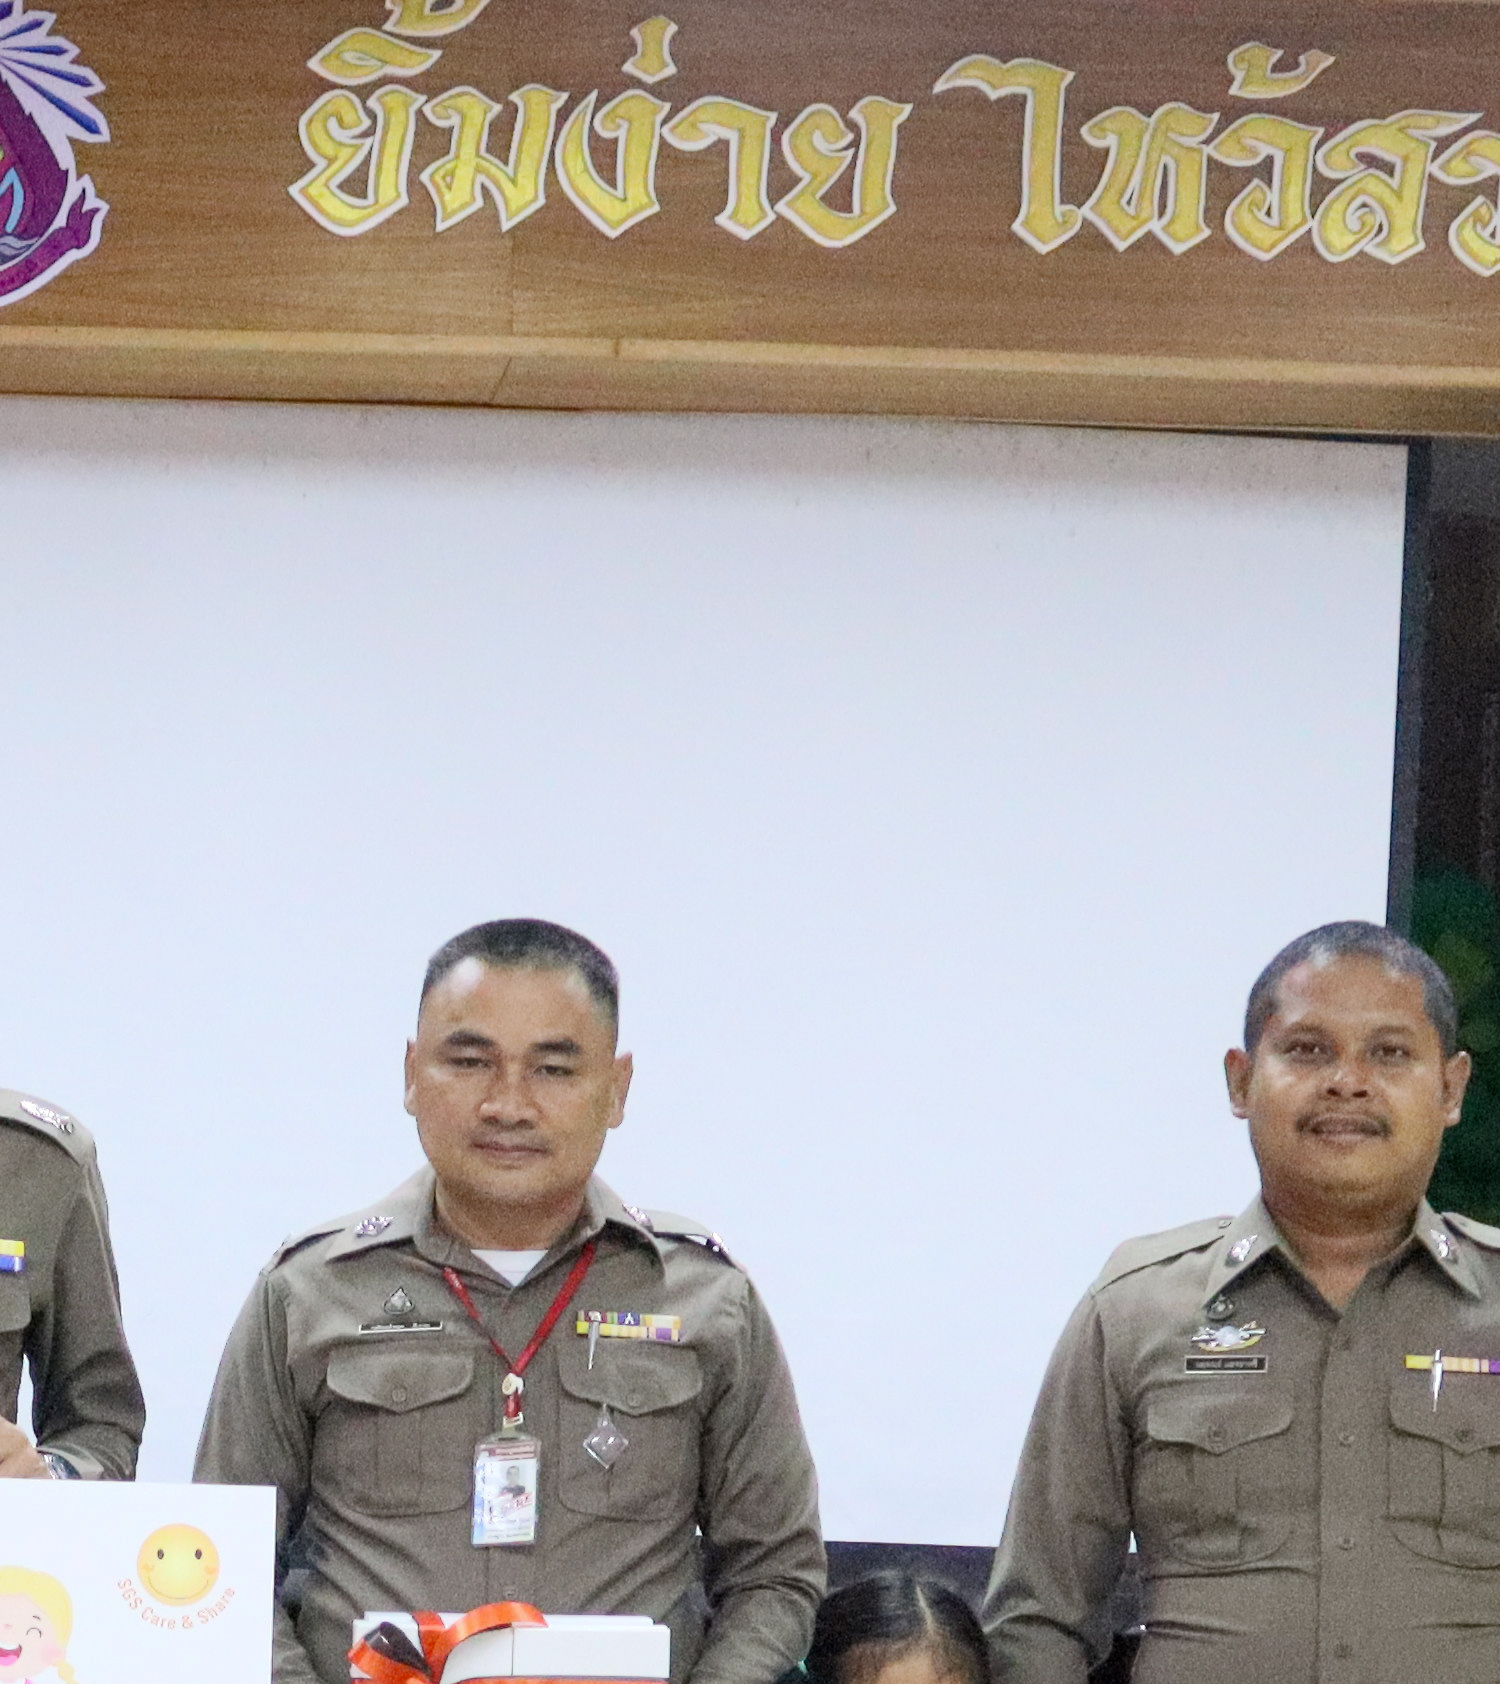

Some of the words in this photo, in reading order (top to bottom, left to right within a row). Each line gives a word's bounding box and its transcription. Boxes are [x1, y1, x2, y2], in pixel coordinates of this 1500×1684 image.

[287, 0, 914, 248] ยิ้มง่าย
[117, 1578, 143, 1610] SGS
[141, 1607, 176, 1630] Care
[182, 1614, 194, 1629] &
[197, 1587, 235, 1624] Share
